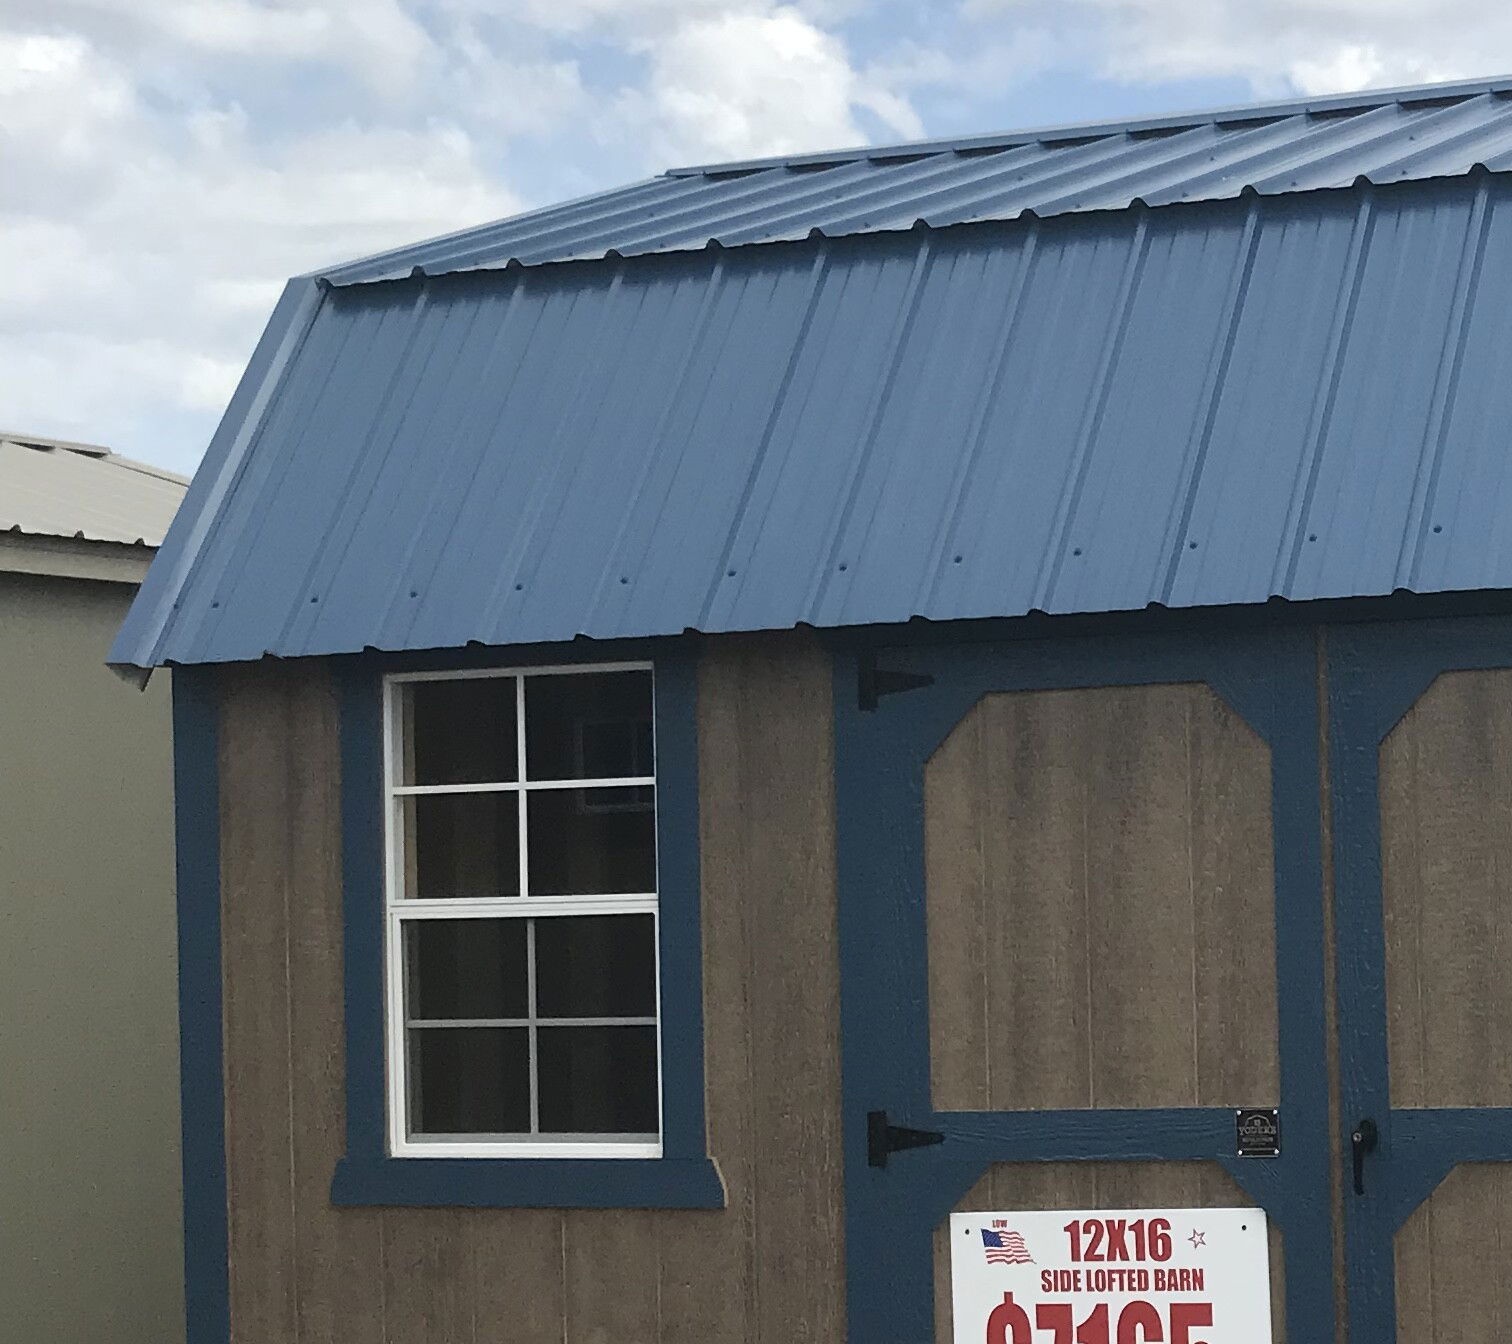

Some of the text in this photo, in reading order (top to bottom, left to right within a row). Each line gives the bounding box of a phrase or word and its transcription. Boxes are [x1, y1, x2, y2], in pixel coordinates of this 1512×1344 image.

[992, 1220, 1008, 1228] LOW
[1063, 1218, 1172, 1262] 12X16
[1041, 1268, 1204, 1293] SIDE LOFTED BARN
